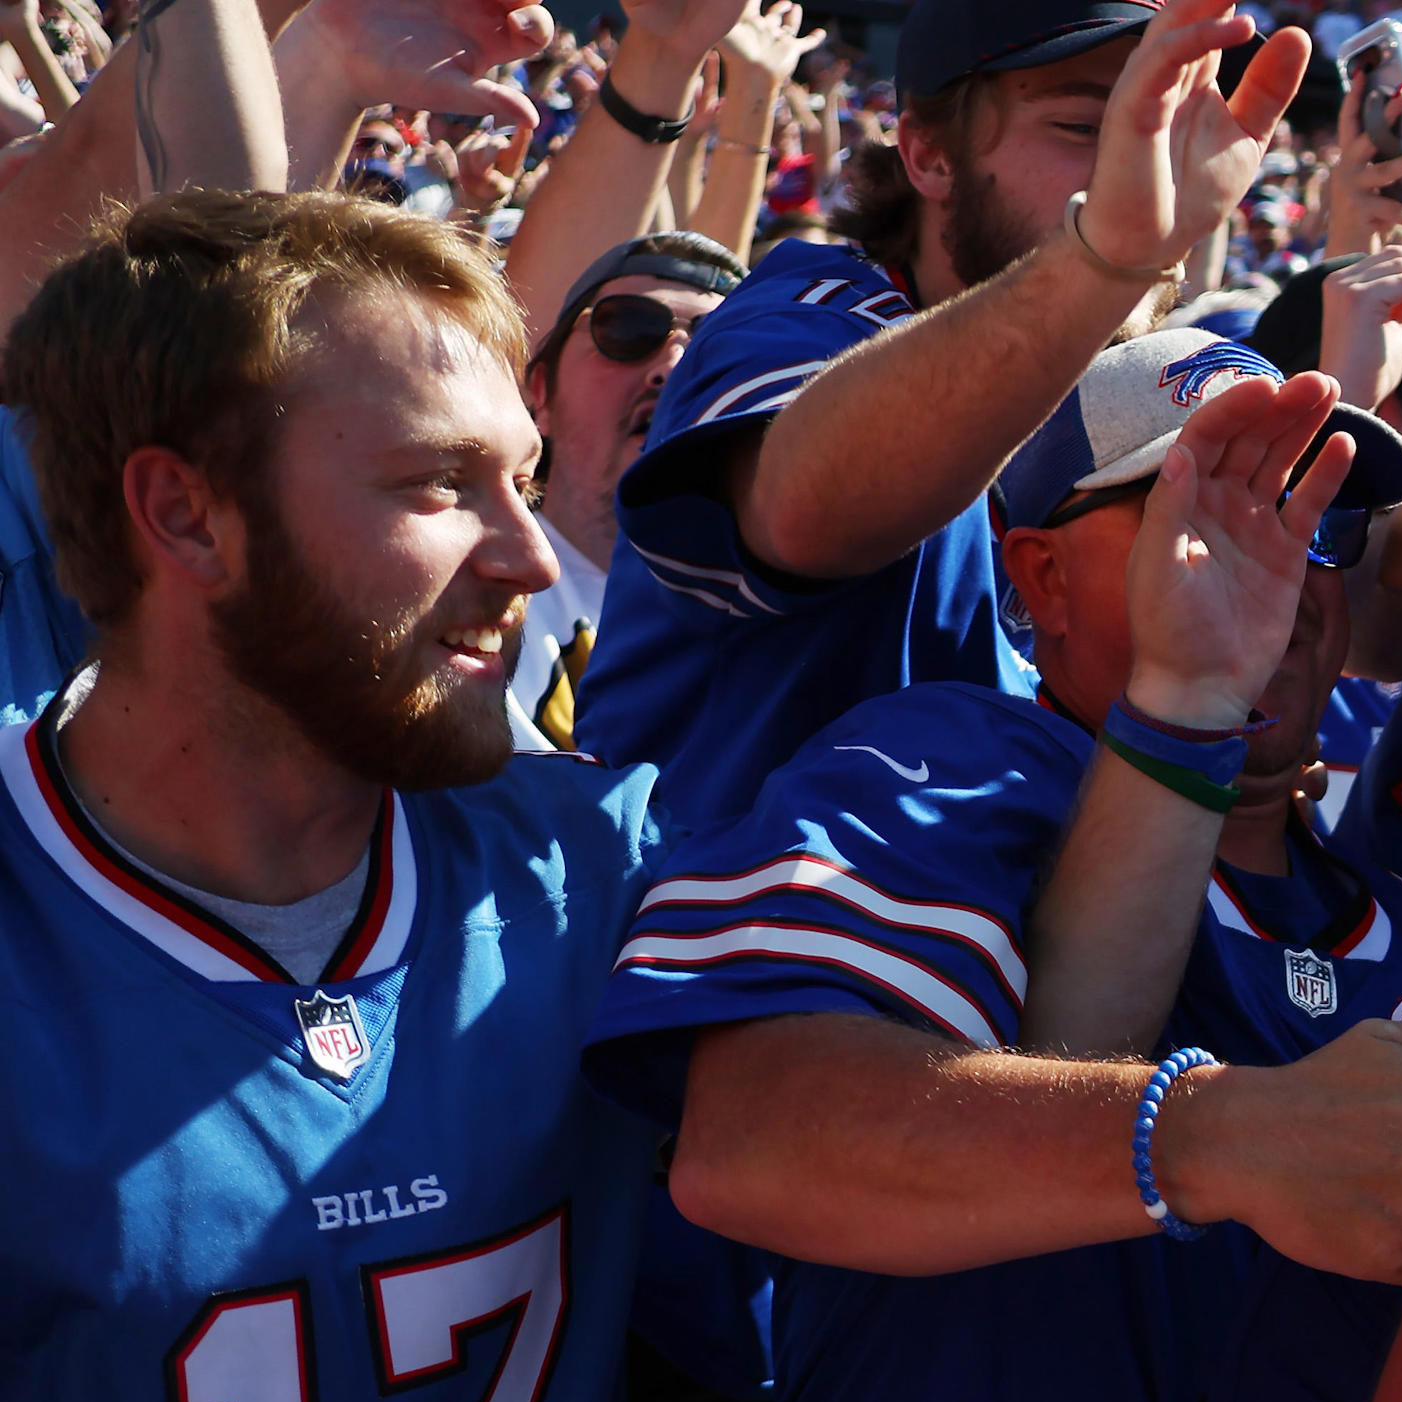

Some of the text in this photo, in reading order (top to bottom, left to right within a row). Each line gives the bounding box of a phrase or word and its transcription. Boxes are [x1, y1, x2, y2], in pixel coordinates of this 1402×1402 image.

[1295, 974, 1330, 1006] NFL
[313, 1027, 360, 1061] NFL
[312, 1174, 448, 1231] BILLS
